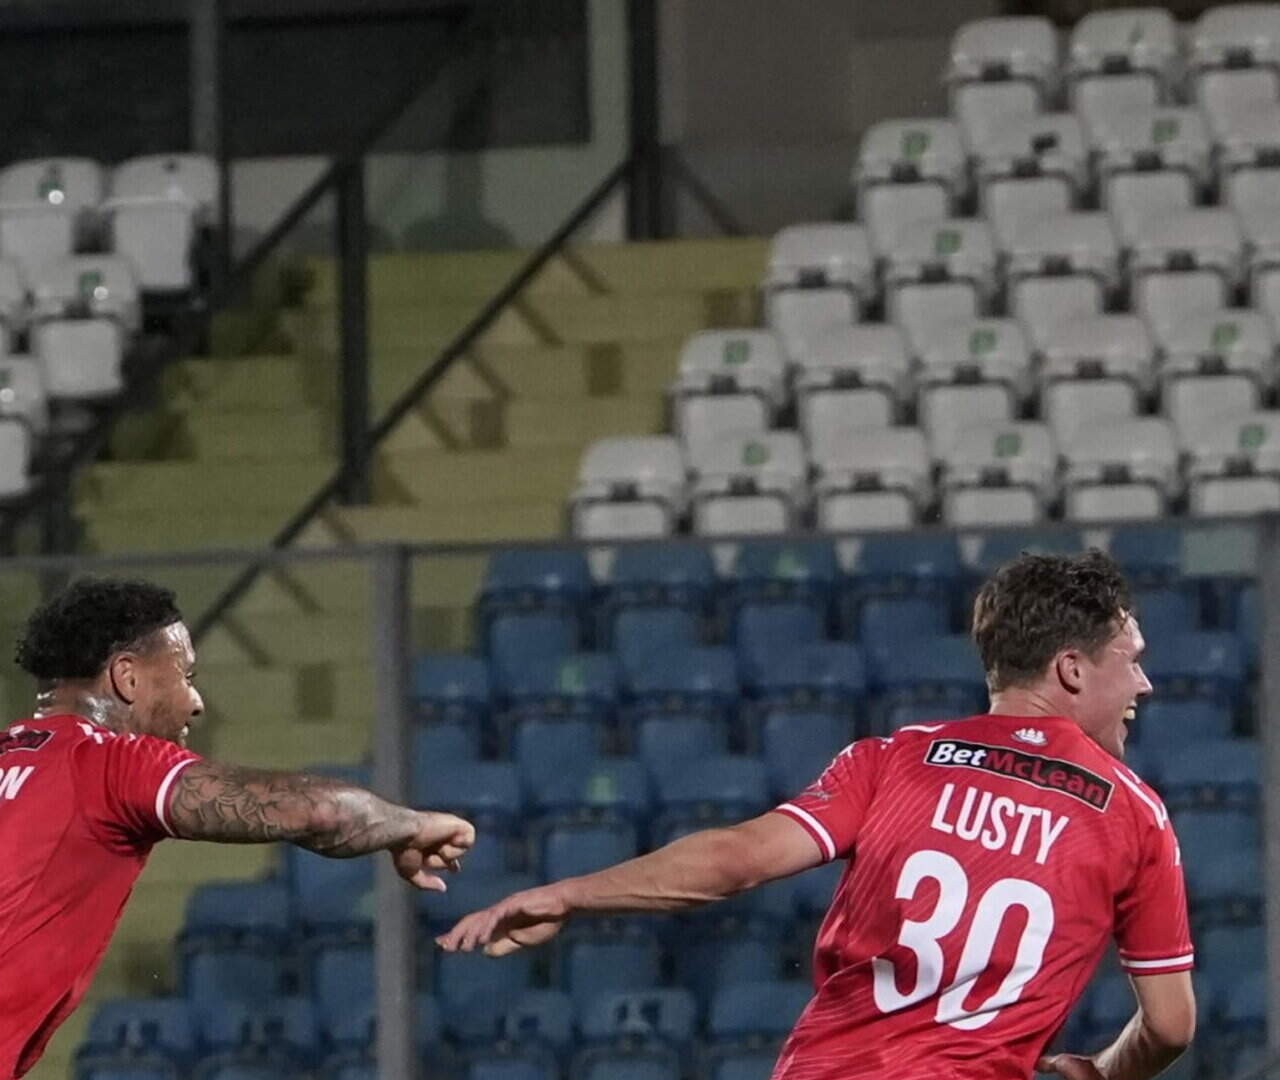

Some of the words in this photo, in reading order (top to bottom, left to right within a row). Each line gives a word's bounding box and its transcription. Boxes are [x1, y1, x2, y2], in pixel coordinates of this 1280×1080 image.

[929, 742, 1107, 805] BetMcLean
[931, 783, 1069, 865] LUSTY
[872, 849, 1055, 1031] 30
